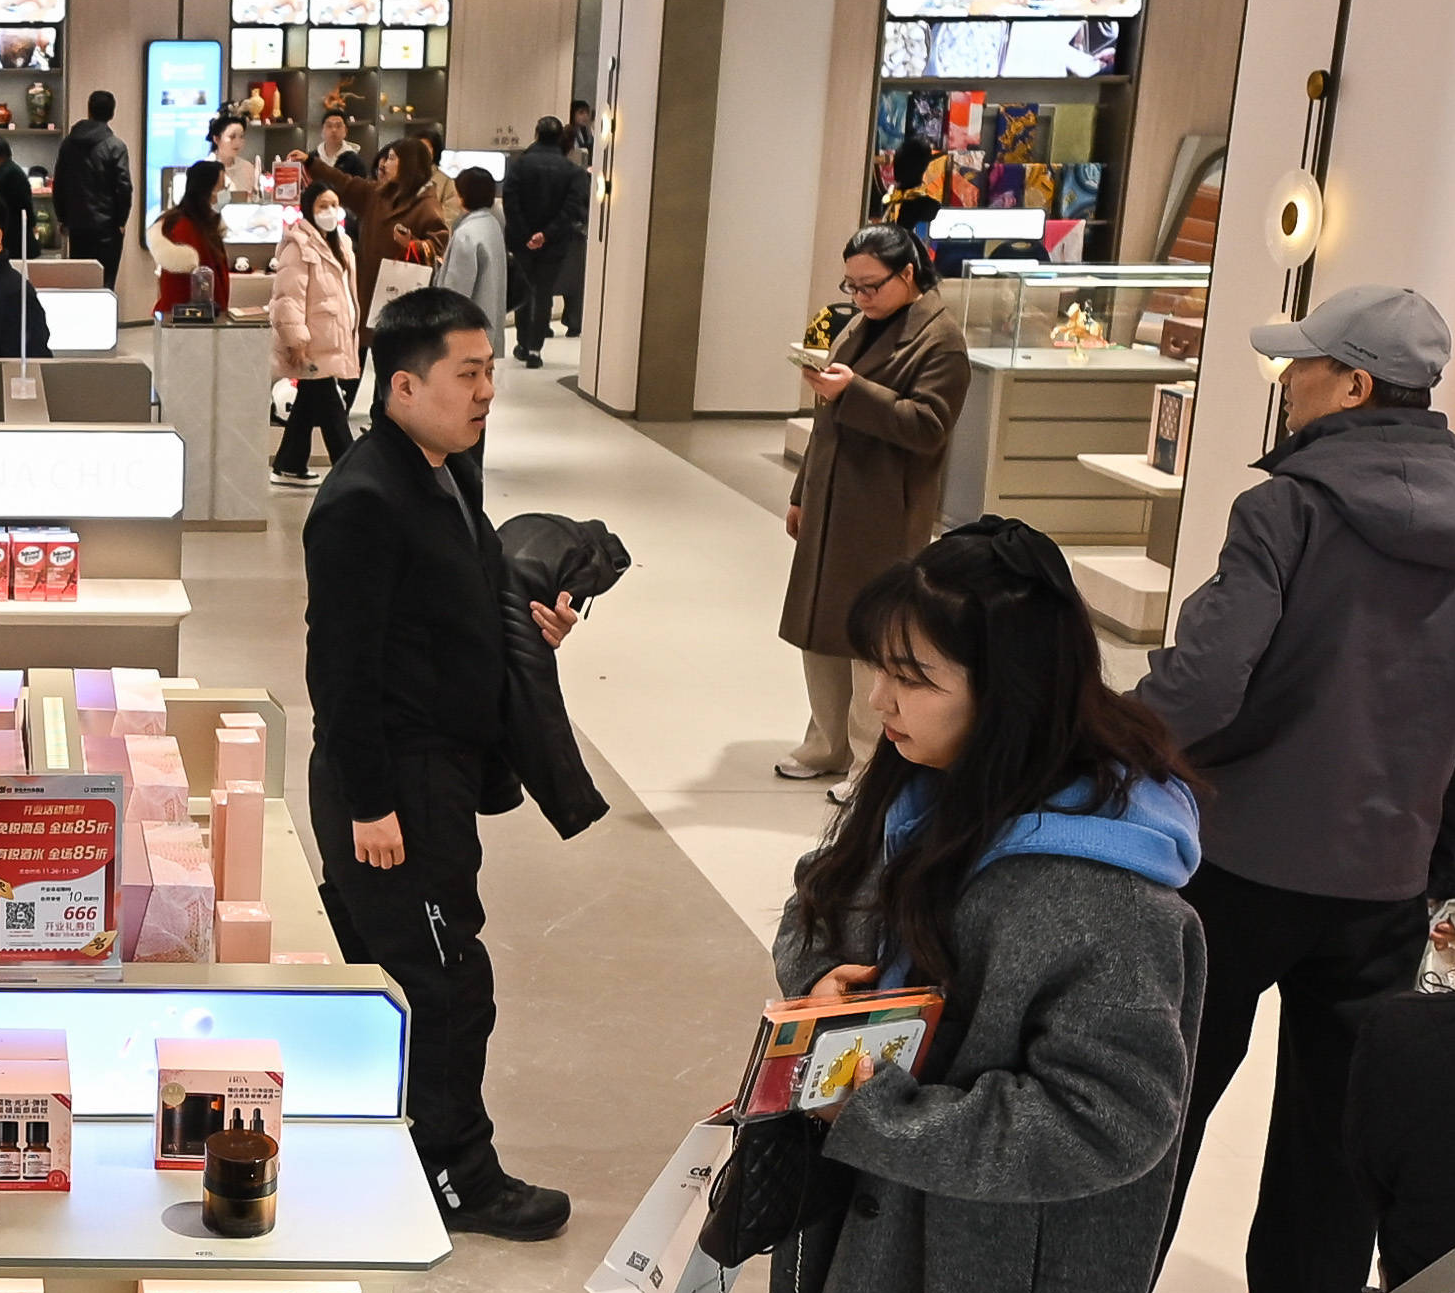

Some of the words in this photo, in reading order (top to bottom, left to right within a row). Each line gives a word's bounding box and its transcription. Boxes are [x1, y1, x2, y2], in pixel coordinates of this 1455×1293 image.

[49, 457, 146, 491] CHIC
[47, 845, 109, 861] 全场85折
[68, 891, 82, 903] 10
[63, 905, 98, 921] 666
